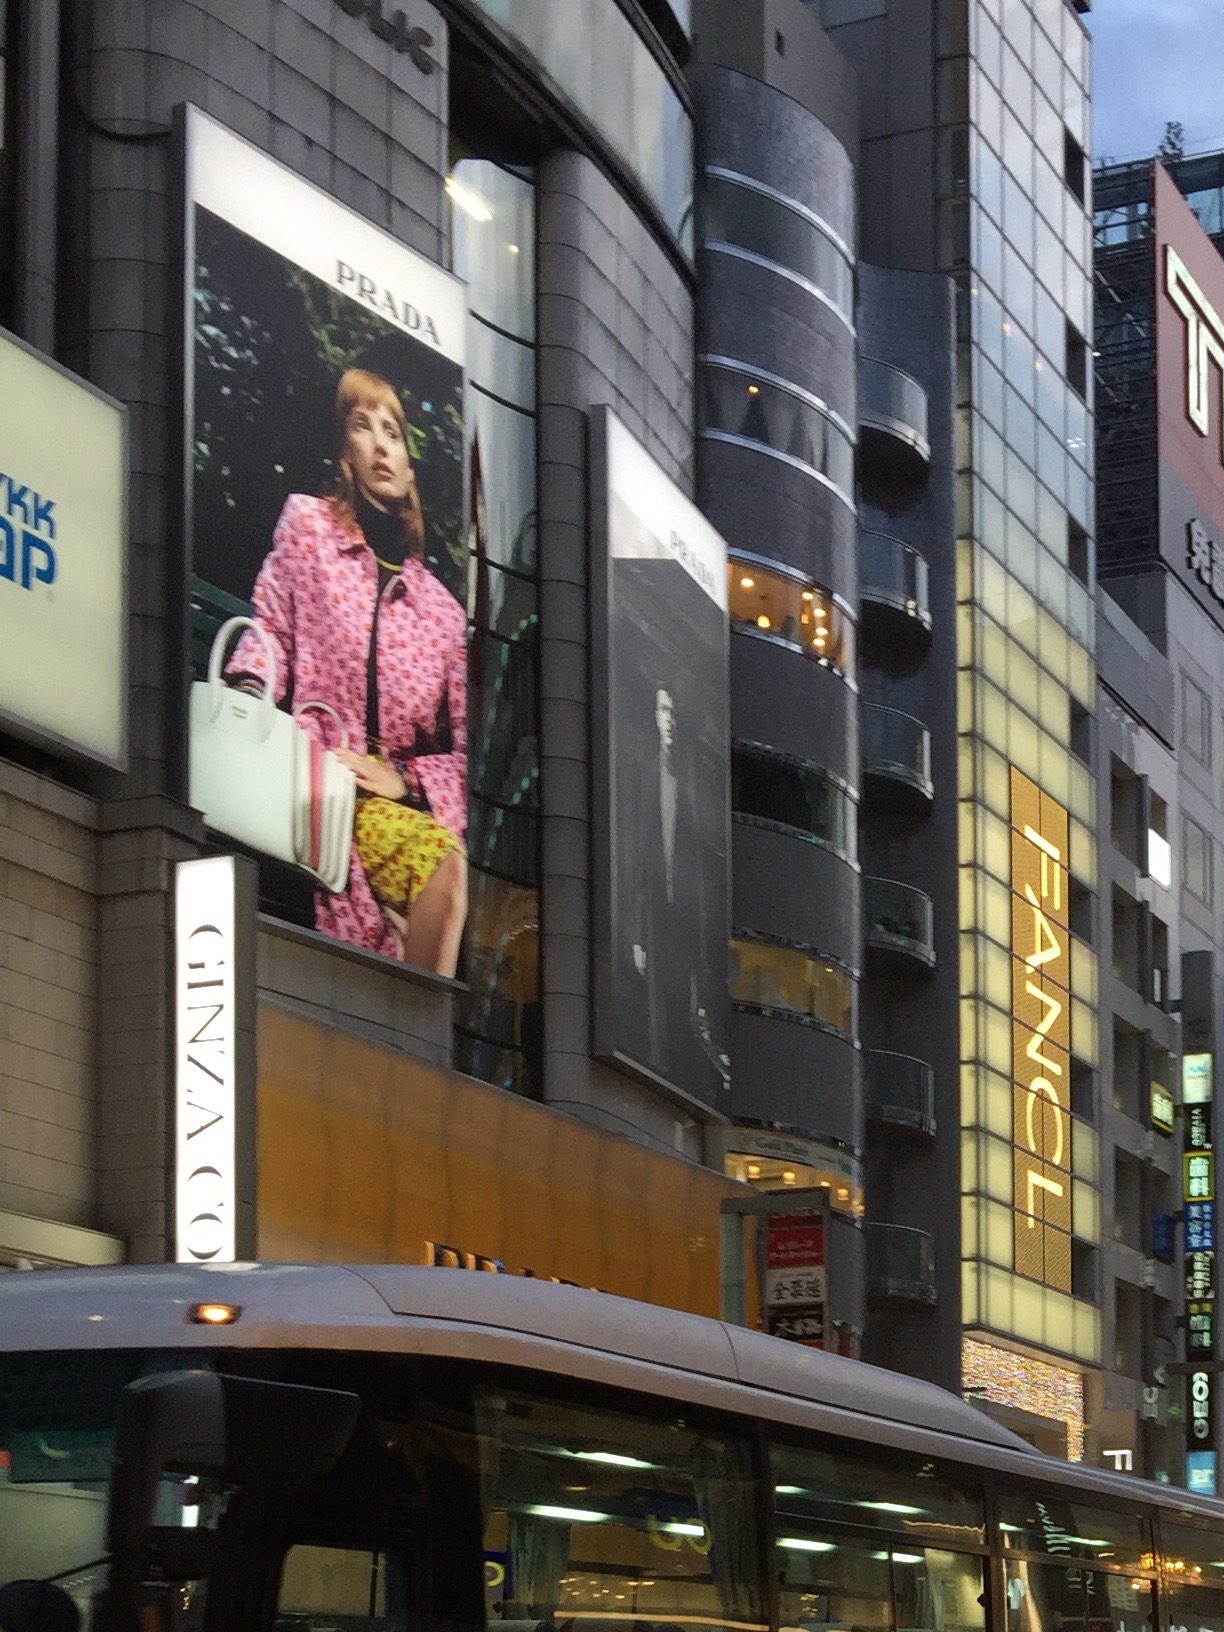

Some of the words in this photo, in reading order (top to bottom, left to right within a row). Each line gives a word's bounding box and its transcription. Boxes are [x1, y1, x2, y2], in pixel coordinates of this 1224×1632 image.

[335, 259, 441, 346] PRADA
[186, 923, 225, 1141] GINZA
[1023, 824, 1064, 1231] FANCL
